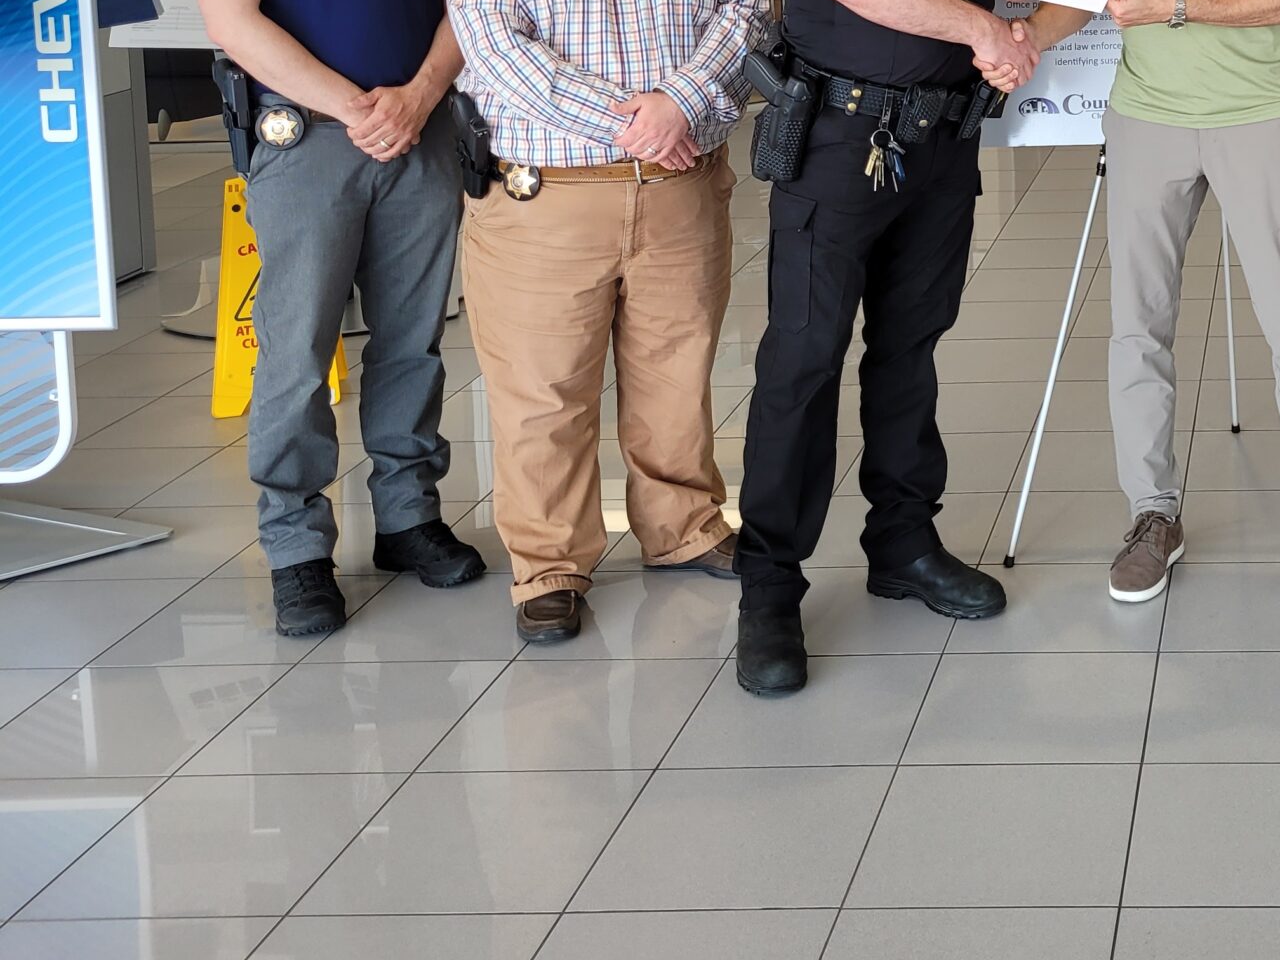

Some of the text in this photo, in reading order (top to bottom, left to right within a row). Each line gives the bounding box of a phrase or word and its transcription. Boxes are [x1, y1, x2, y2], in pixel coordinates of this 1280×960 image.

[1059, 43, 1073, 51] aid
[1074, 43, 1089, 51] law
[1055, 56, 1099, 66] identifying
[235, 325, 253, 337] AT
